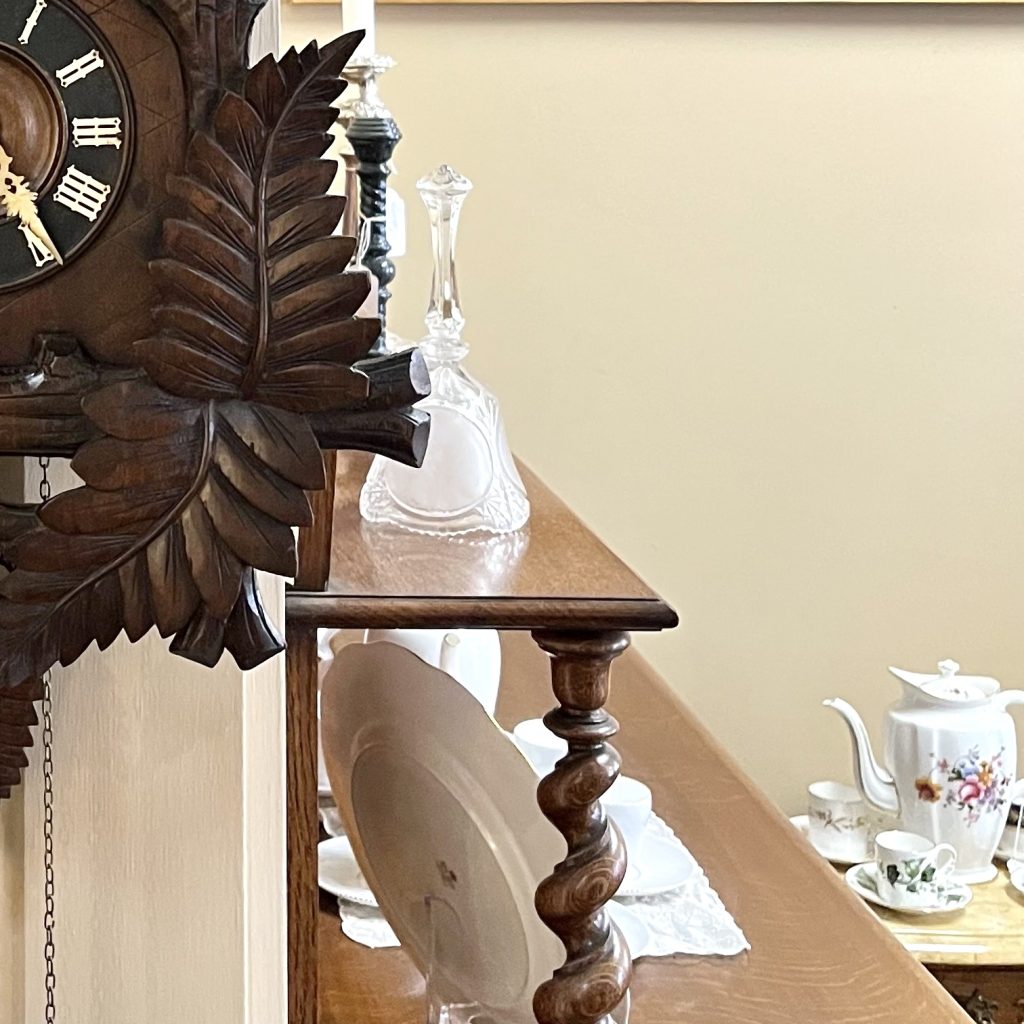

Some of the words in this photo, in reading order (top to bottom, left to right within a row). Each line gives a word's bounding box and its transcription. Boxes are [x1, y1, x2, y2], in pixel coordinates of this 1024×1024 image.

[18, 0, 47, 45] I
[56, 49, 104, 88] II
[72, 117, 122, 149] III
[53, 164, 111, 222] IIII
[18, 222, 54, 267] V
